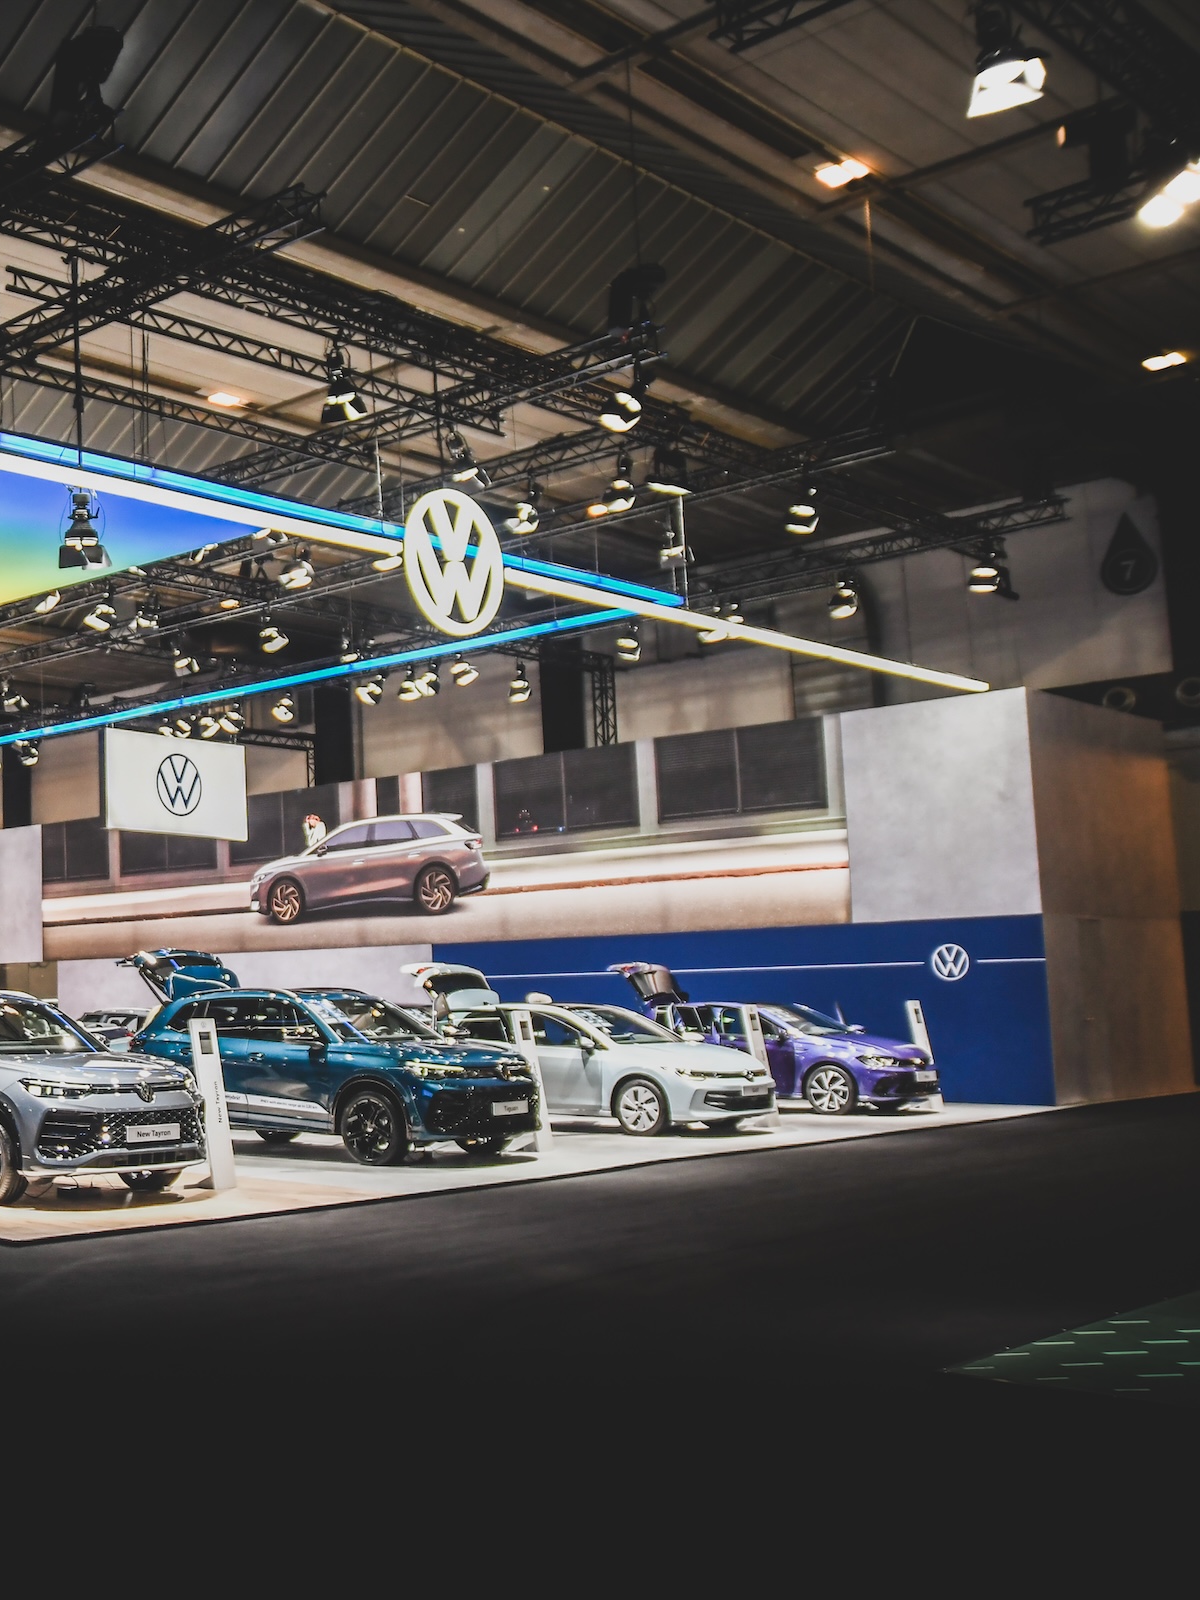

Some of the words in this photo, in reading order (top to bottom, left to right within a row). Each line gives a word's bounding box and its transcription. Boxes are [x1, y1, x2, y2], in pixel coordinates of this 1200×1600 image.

[1121, 559, 1136, 580] 7
[157, 753, 202, 816] VW
[932, 943, 970, 981] VW
[151, 1130, 171, 1138] Tayron
